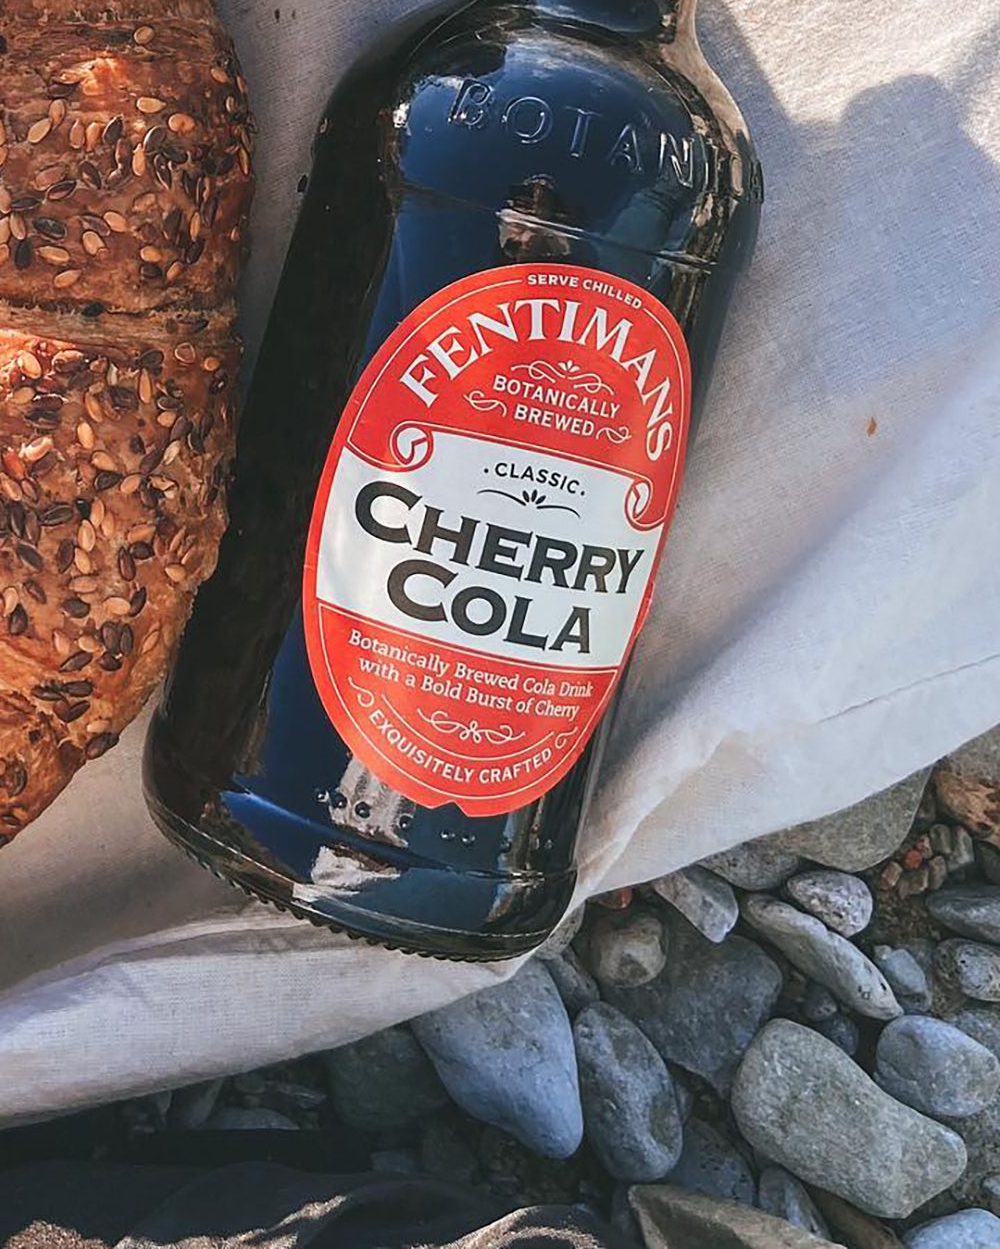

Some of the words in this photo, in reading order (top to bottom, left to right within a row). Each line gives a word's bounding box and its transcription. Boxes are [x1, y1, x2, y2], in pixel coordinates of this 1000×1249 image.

[526, 273, 579, 289] SERVE
[582, 278, 643, 310] CHILLED
[399, 298, 674, 462] FENTIMANS
[492, 374, 621, 419] BOTANICALLY
[513, 402, 596, 438] BREWED
[494, 462, 581, 495] CLASSIC
[354, 480, 646, 594] CHERRY
[386, 558, 592, 654] COLA
[348, 628, 451, 678] Botanically
[453, 661, 520, 691] Brewed
[522, 676, 556, 696] Cola
[558, 681, 594, 699] Drink
[358, 656, 400, 683] with
[404, 673, 417, 688] a
[420, 674, 464, 700] Bold
[465, 687, 513, 712] Burst
[515, 699, 534, 715] of
[534, 699, 580, 722] Cherry
[367, 709, 475, 784] EXQUISITELY
[478, 747, 553, 784] CRAFTED
